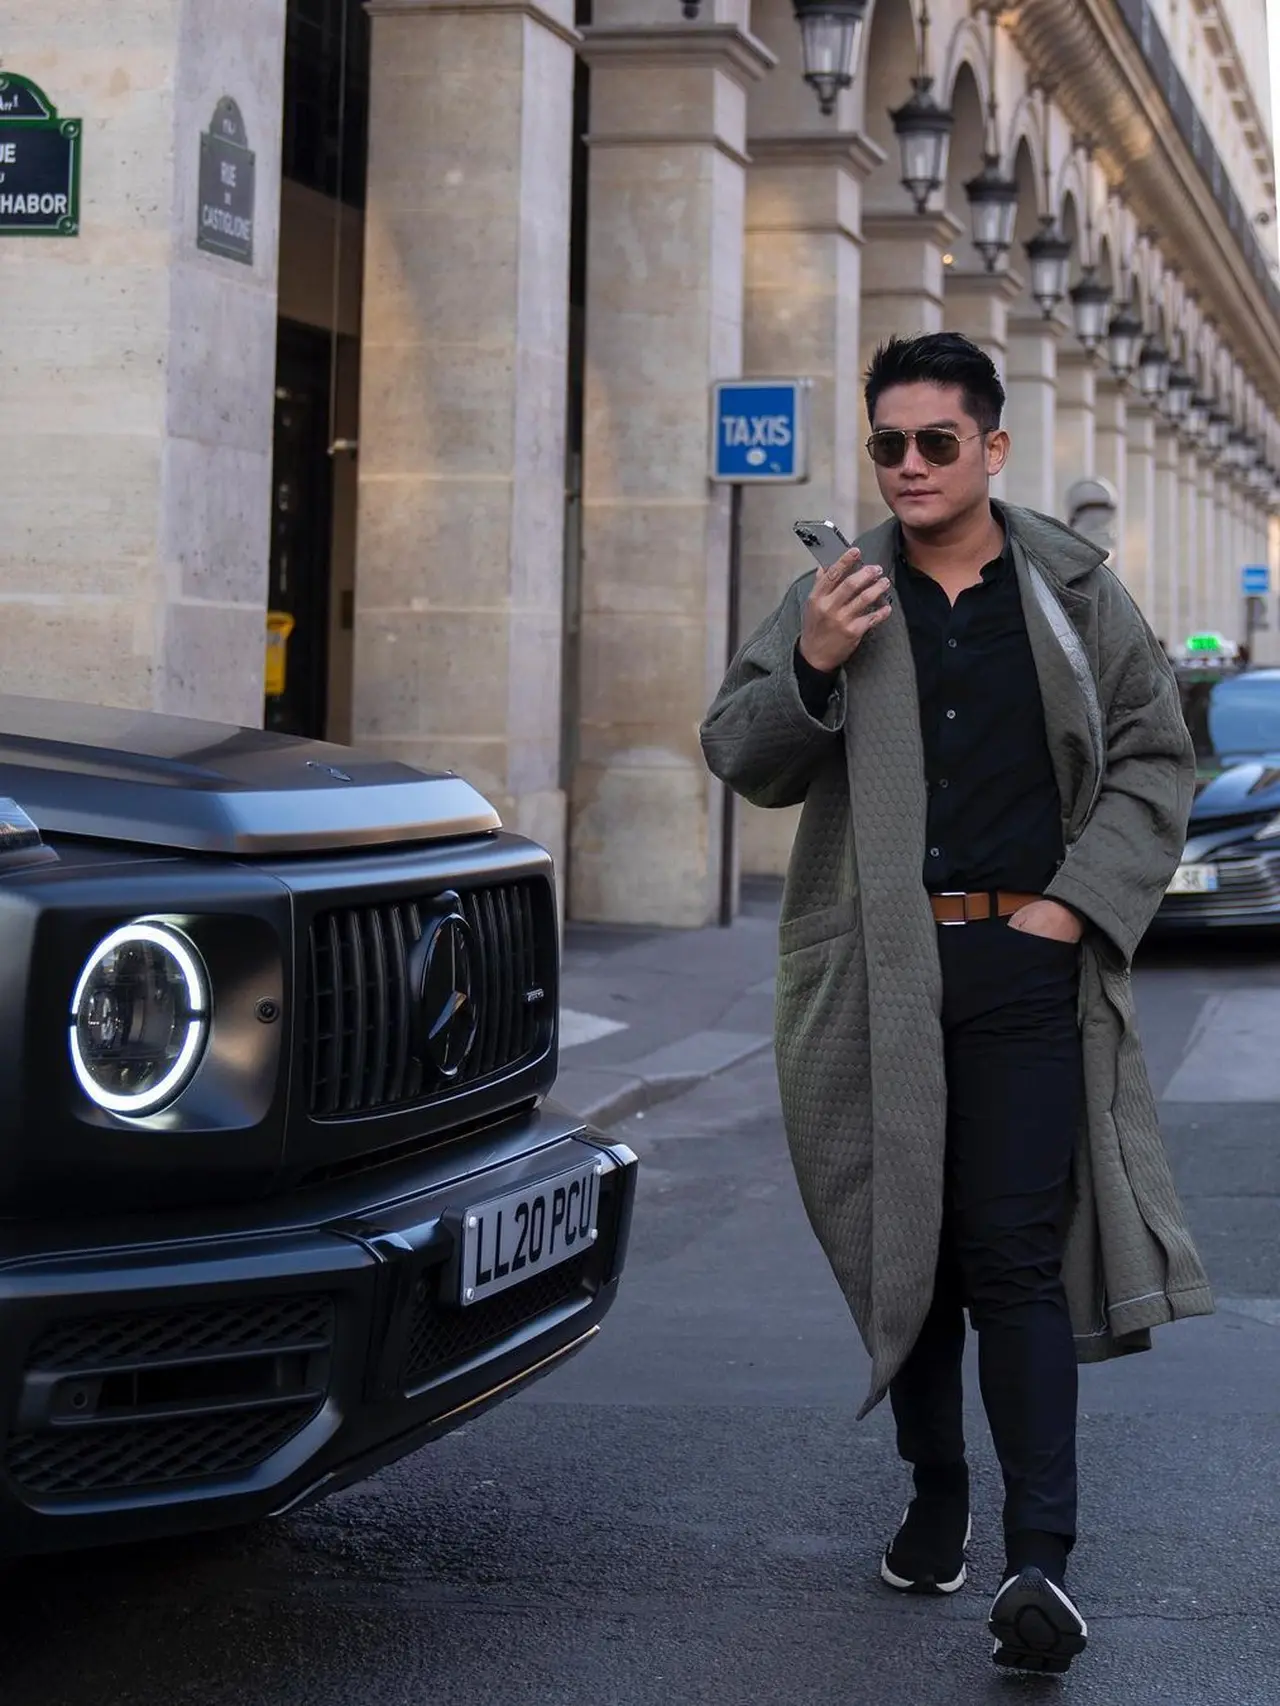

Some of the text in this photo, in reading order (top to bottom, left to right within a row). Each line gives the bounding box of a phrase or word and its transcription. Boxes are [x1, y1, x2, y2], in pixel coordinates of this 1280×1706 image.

[0, 193, 67, 214] HABOR
[721, 415, 792, 447] TAXIS
[475, 1172, 594, 1287] LL20 PCU
